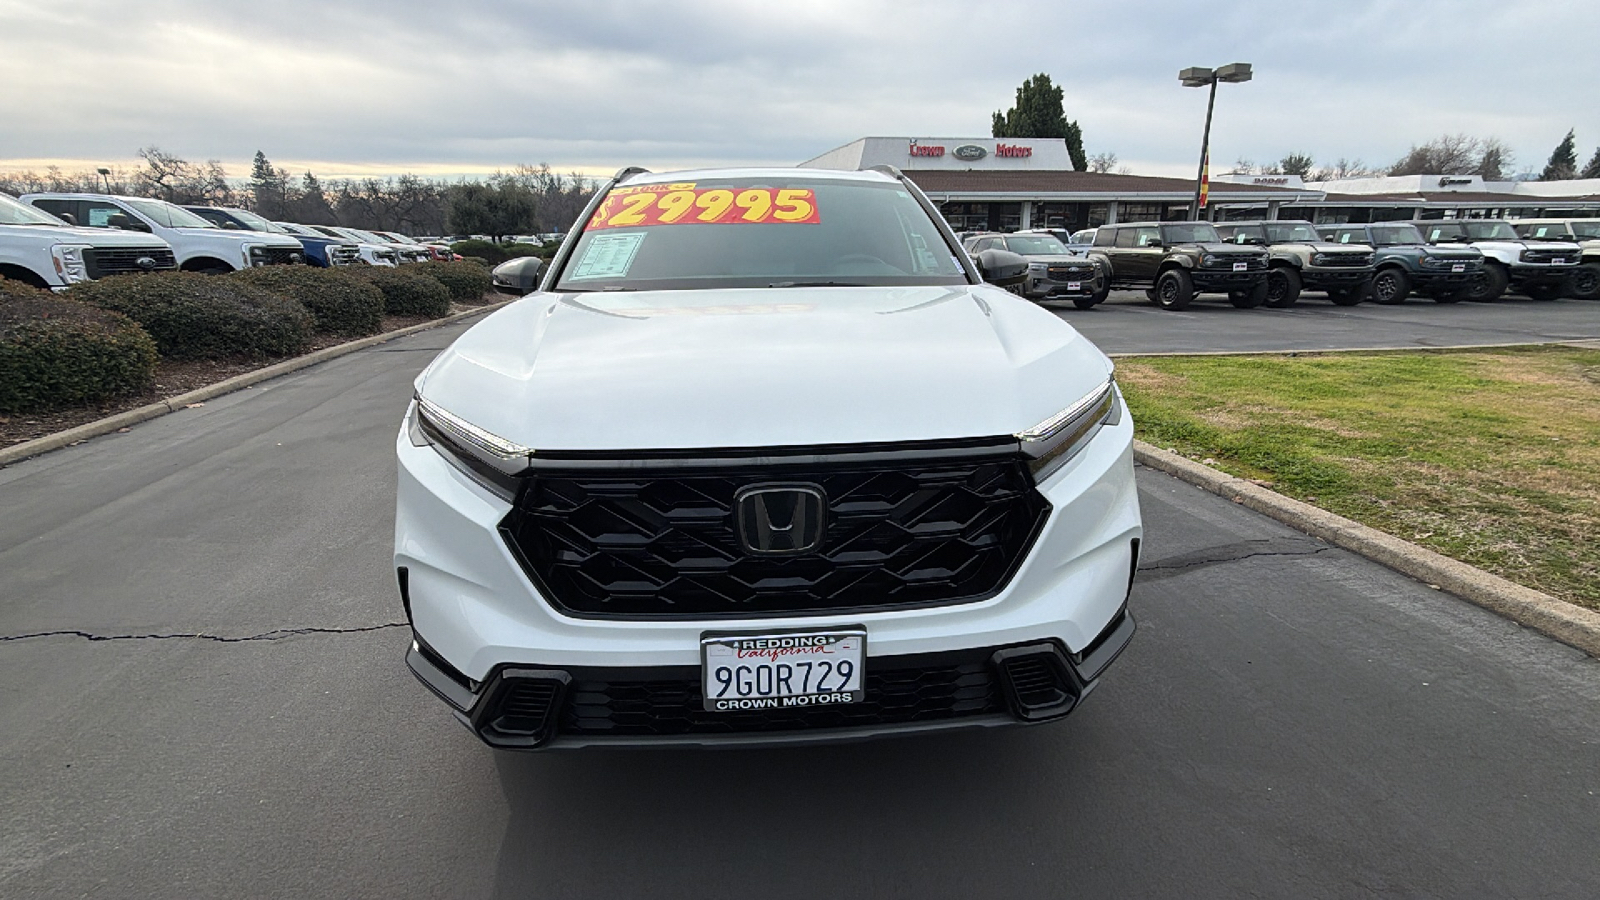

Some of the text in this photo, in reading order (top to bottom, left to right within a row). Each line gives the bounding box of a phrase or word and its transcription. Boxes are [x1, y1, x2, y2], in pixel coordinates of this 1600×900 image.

[909, 143, 1032, 157] Crown Motors
[1253, 177, 1288, 185] DODGE
[591, 188, 815, 227] $29995
[742, 636, 827, 650] REDDING
[715, 659, 854, 698] 9GOR729
[716, 692, 852, 710] CROWN MOTORS
